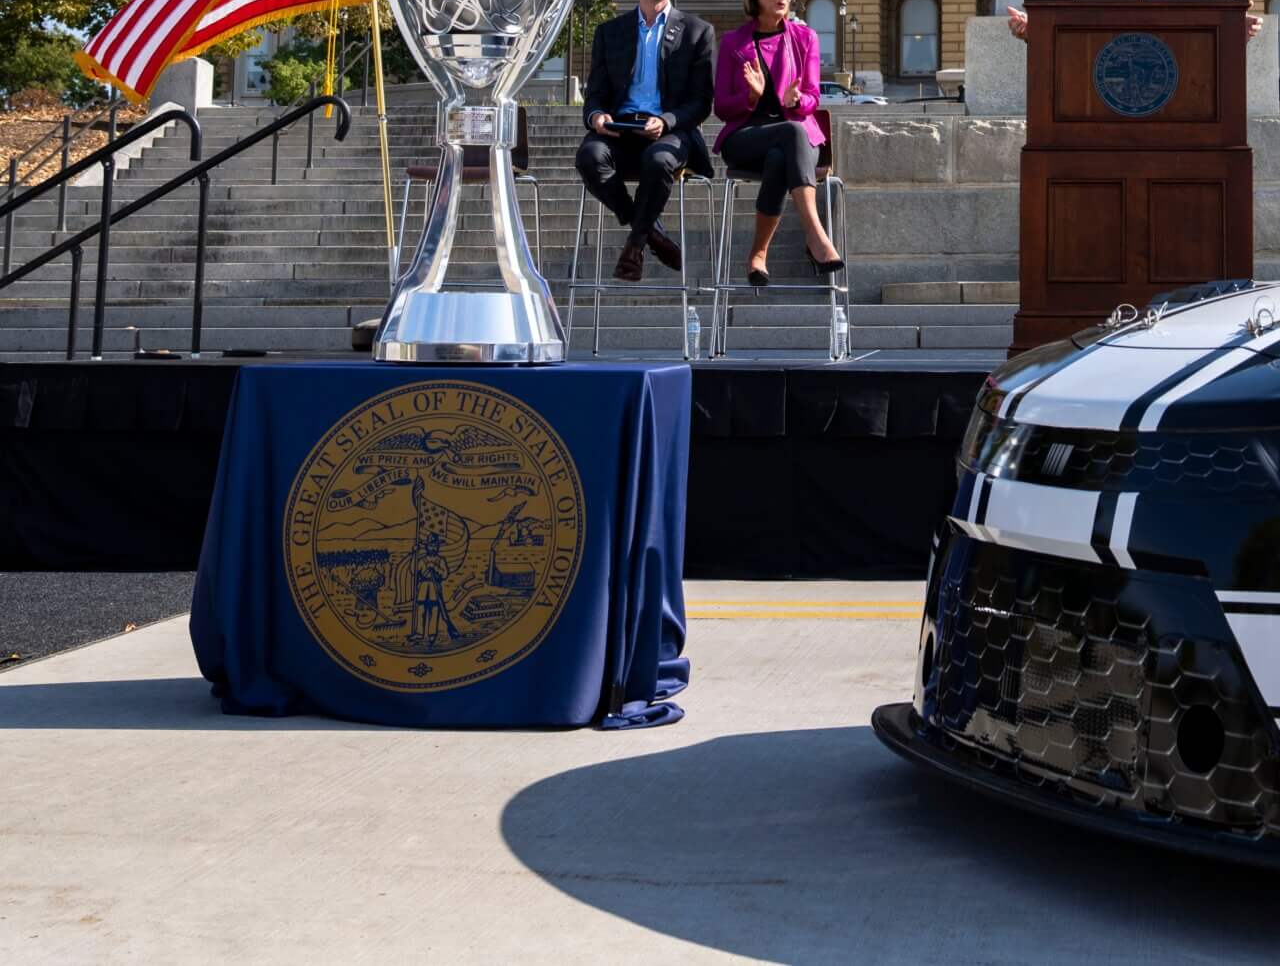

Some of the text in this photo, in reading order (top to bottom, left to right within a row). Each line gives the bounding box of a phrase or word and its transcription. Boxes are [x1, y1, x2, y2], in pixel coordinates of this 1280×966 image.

[357, 454, 436, 466] WE PRIZE AND
[452, 452, 520, 465] OUR RIGHTS
[431, 468, 537, 488] WE WILL MAINTAIN
[328, 467, 410, 510] OUR LIBERTIES
[293, 391, 577, 620] THE GREAT SEAL OF THE STATE OF IOWA
